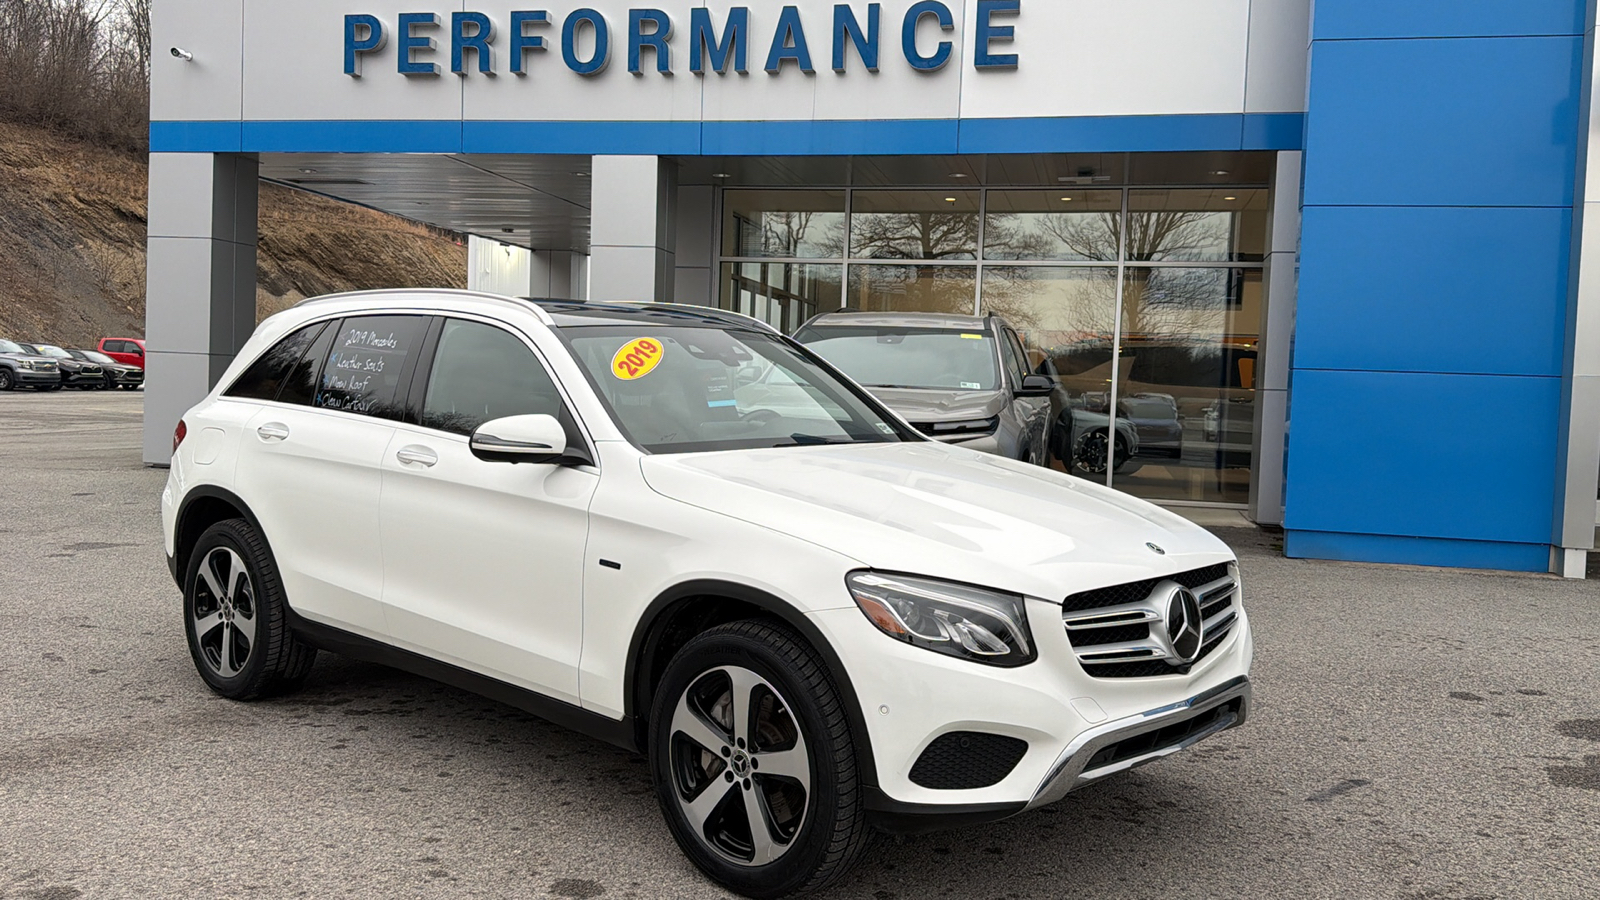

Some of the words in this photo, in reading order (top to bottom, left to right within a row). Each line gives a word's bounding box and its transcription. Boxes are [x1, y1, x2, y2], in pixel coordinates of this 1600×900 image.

[344, 0, 1020, 77] PERFORMANCE
[345, 329, 367, 346] 2019
[367, 331, 397, 348] Mercedes
[337, 353, 362, 369] Leather
[363, 356, 384, 371] Seats
[618, 340, 658, 376] 2019
[329, 376, 347, 389] Moon
[348, 375, 371, 391] Roof
